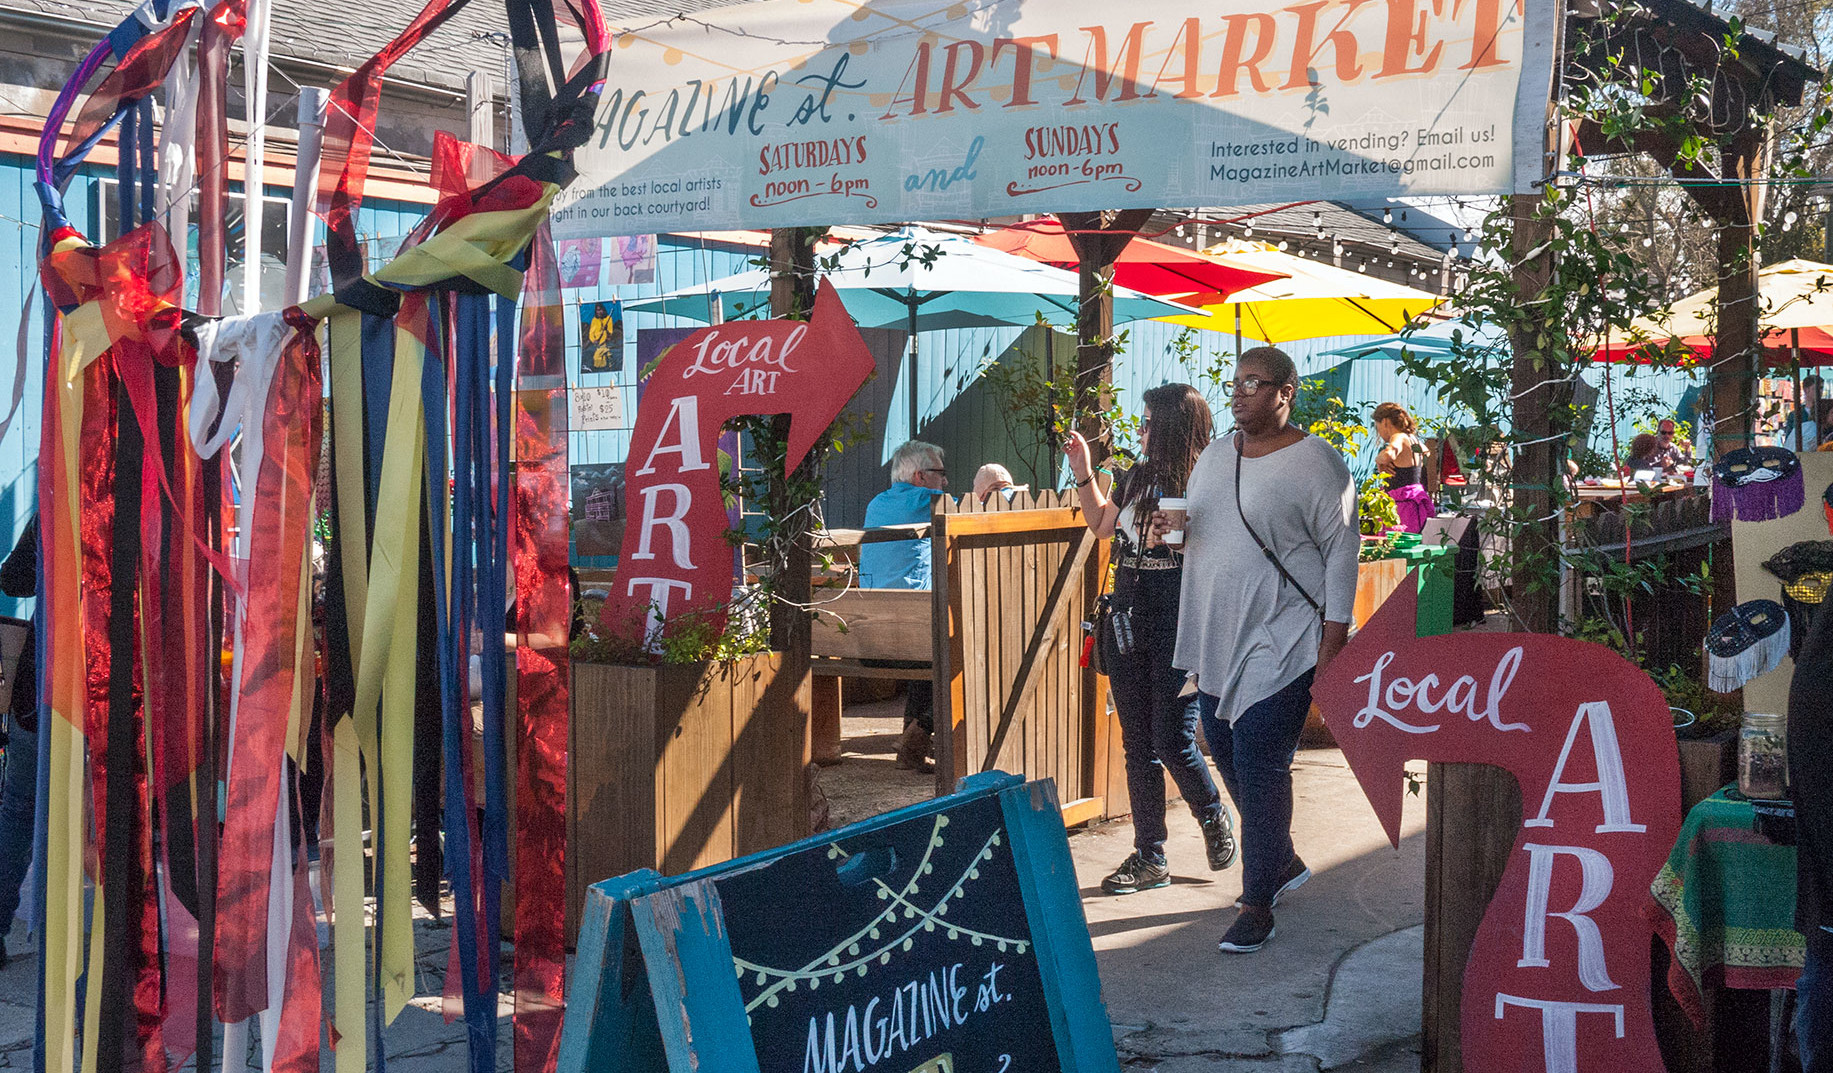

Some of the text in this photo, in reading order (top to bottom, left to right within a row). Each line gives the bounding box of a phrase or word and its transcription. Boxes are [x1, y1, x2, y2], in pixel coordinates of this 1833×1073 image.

[592, 0, 1524, 151] AGAZINE st. ART MARKET
[759, 135, 867, 176] SATURDAYS
[1023, 122, 1120, 160] SUNDAYS
[1211, 124, 1495, 158] Interested in vending? Email us!
[904, 135, 985, 192] and
[1210, 153, 1495, 183] MagazineArtMarket@gmail.com
[572, 187, 595, 200] from
[600, 185, 617, 198] the
[622, 182, 647, 196] best
[651, 179, 681, 194] local
[686, 177, 722, 192] artists
[765, 179, 809, 198] noon
[830, 173, 869, 196] 6pm
[577, 206, 587, 219] in
[591, 207, 611, 219] our
[614, 203, 643, 217] back
[647, 197, 710, 215] courtyard!
[682, 324, 809, 379] Local
[724, 367, 781, 396] ART
[627, 395, 711, 655] ART
[1353, 646, 1532, 734] Local
[1495, 700, 1647, 1073] ART
[804, 961, 1012, 1073] MAGAZINE st.
